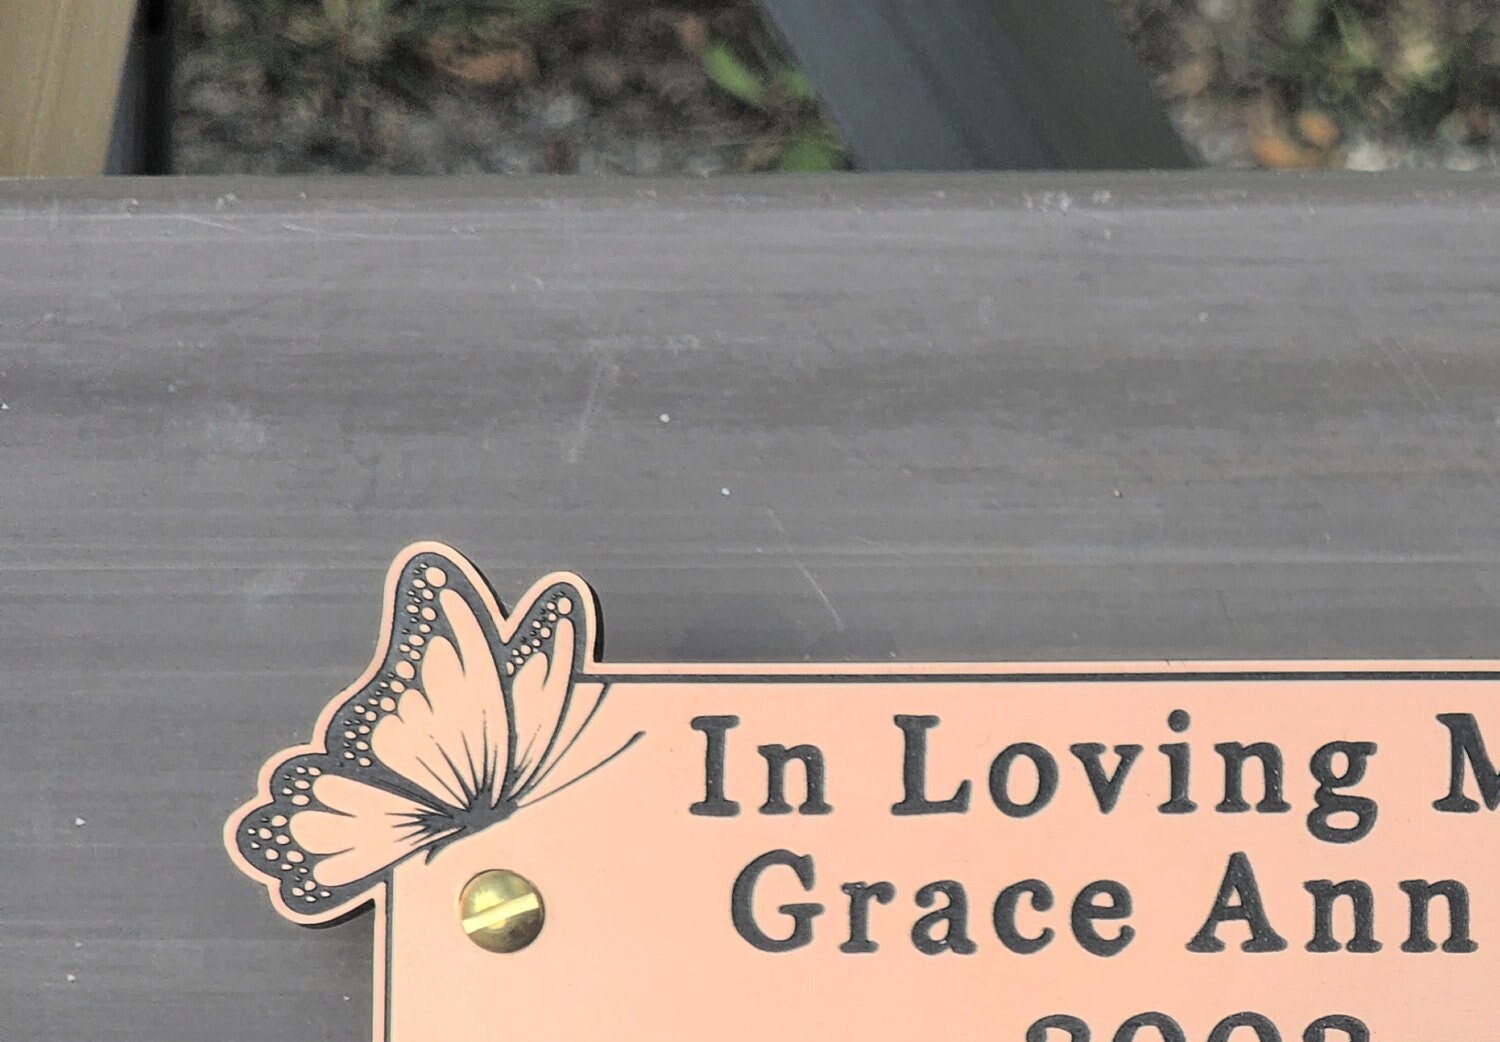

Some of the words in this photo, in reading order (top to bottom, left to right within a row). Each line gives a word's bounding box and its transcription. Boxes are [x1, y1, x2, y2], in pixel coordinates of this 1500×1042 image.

[690, 714, 832, 817] In
[891, 709, 1378, 846] Loving
[730, 848, 1135, 957] Grace
[1185, 851, 1478, 955] Ann
